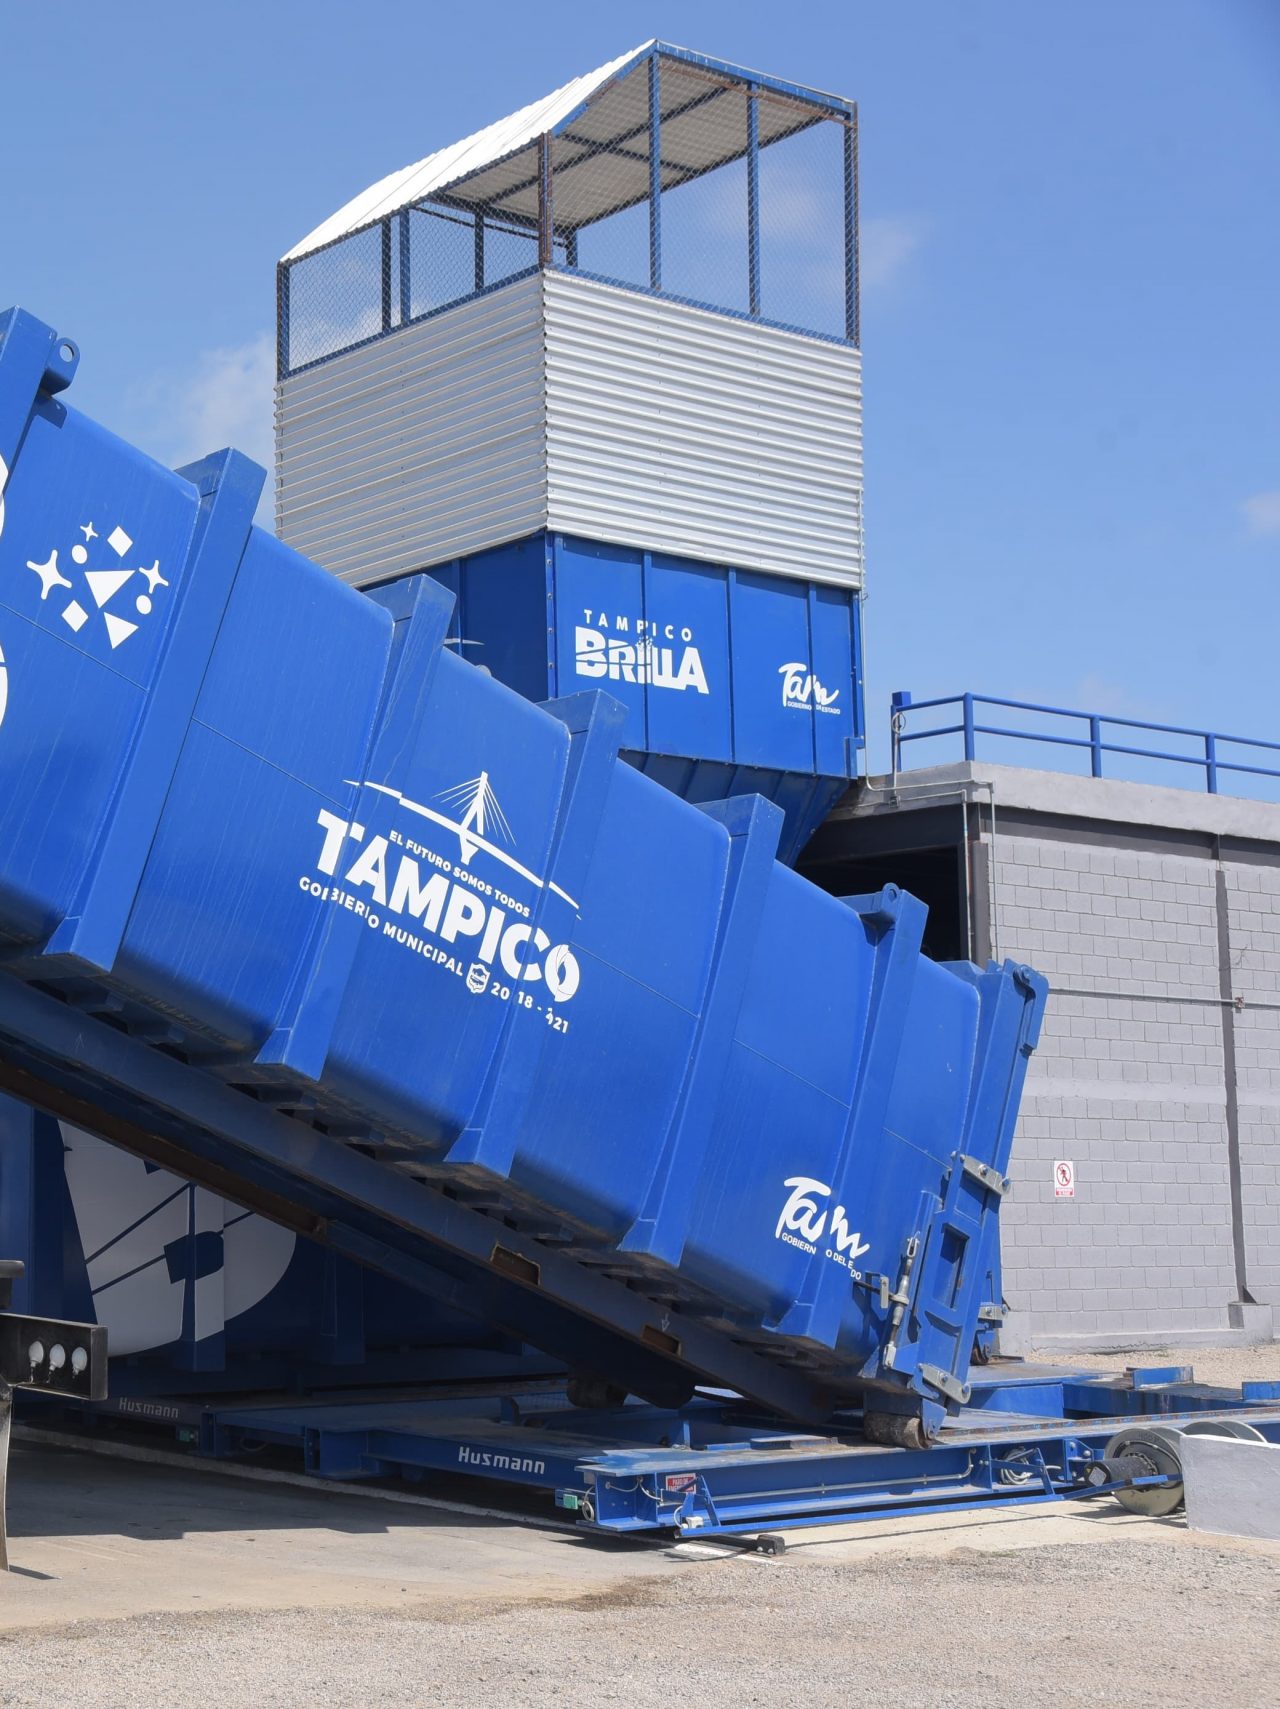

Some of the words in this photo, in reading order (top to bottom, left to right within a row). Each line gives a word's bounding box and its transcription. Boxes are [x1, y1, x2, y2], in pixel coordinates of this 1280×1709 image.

[584, 609, 692, 642] TAMPICO
[575, 626, 710, 695] BRILLA
[389, 830, 403, 846] EL
[406, 839, 451, 872] FUTURO
[453, 866, 492, 895] SOMOS
[494, 889, 530, 918] TODOS
[317, 808, 580, 1003] TAMPICO
[383, 922, 463, 977] MUNICIPAL
[119, 1397, 180, 1419] Husmann
[458, 1446, 545, 1475] Husmann
